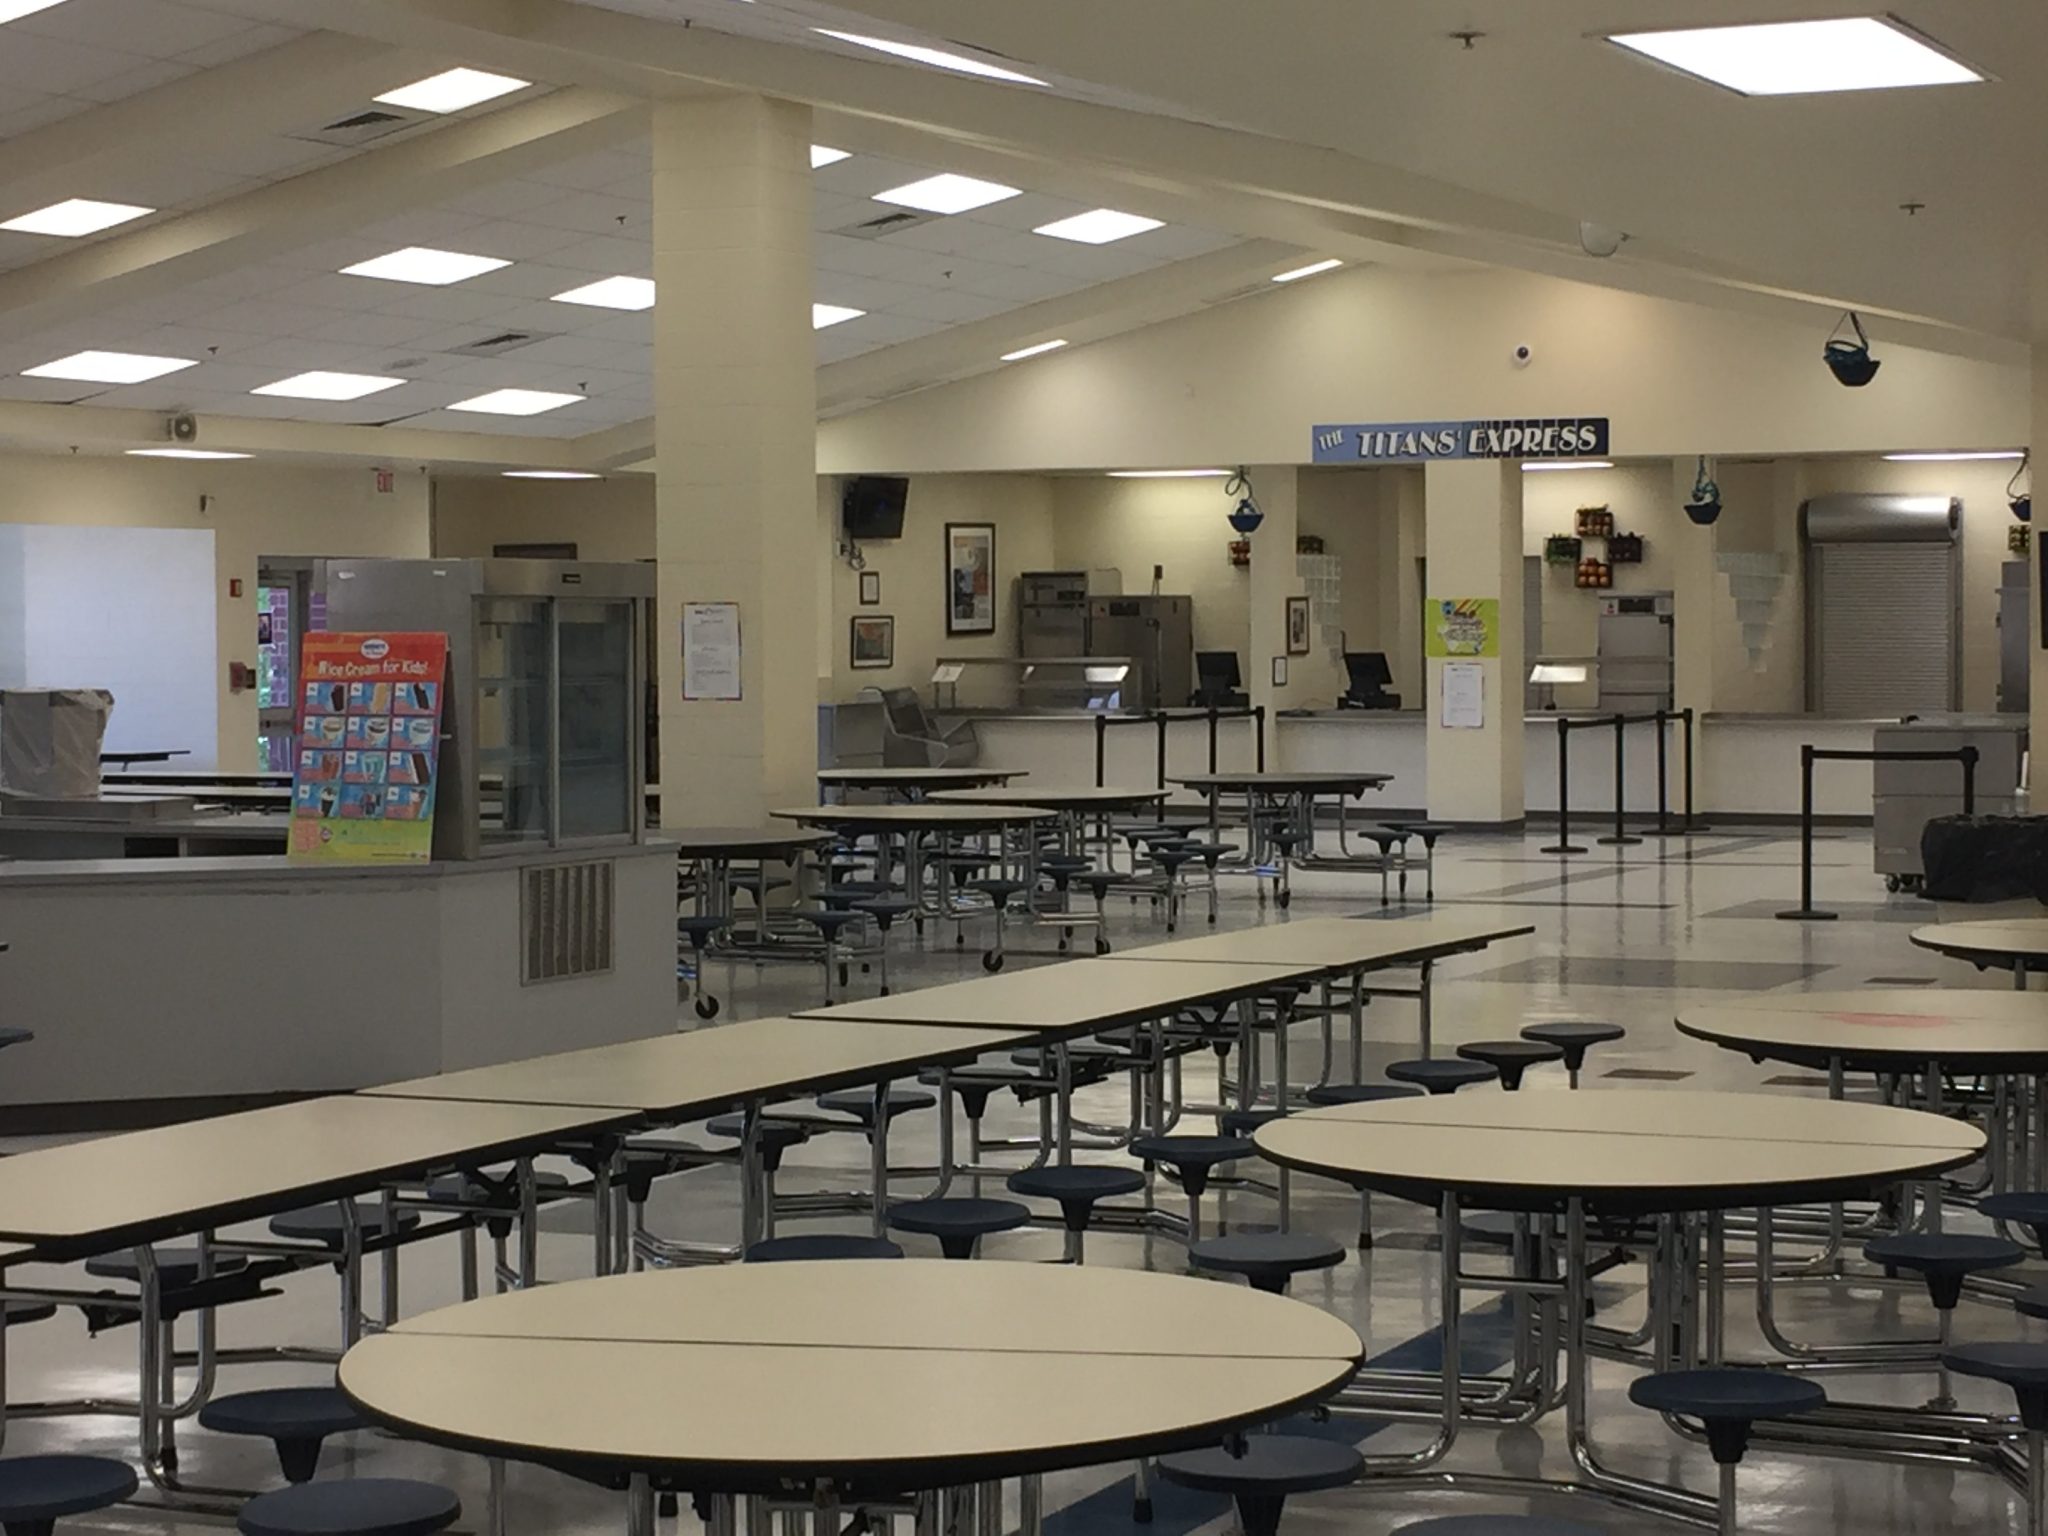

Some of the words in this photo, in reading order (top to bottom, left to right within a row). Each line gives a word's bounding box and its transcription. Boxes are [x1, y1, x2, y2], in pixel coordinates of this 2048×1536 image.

[1319, 429, 1343, 451] THE
[1468, 425, 1597, 453] EXPRESS
[345, 662, 380, 676] Cream
[383, 659, 400, 674] for
